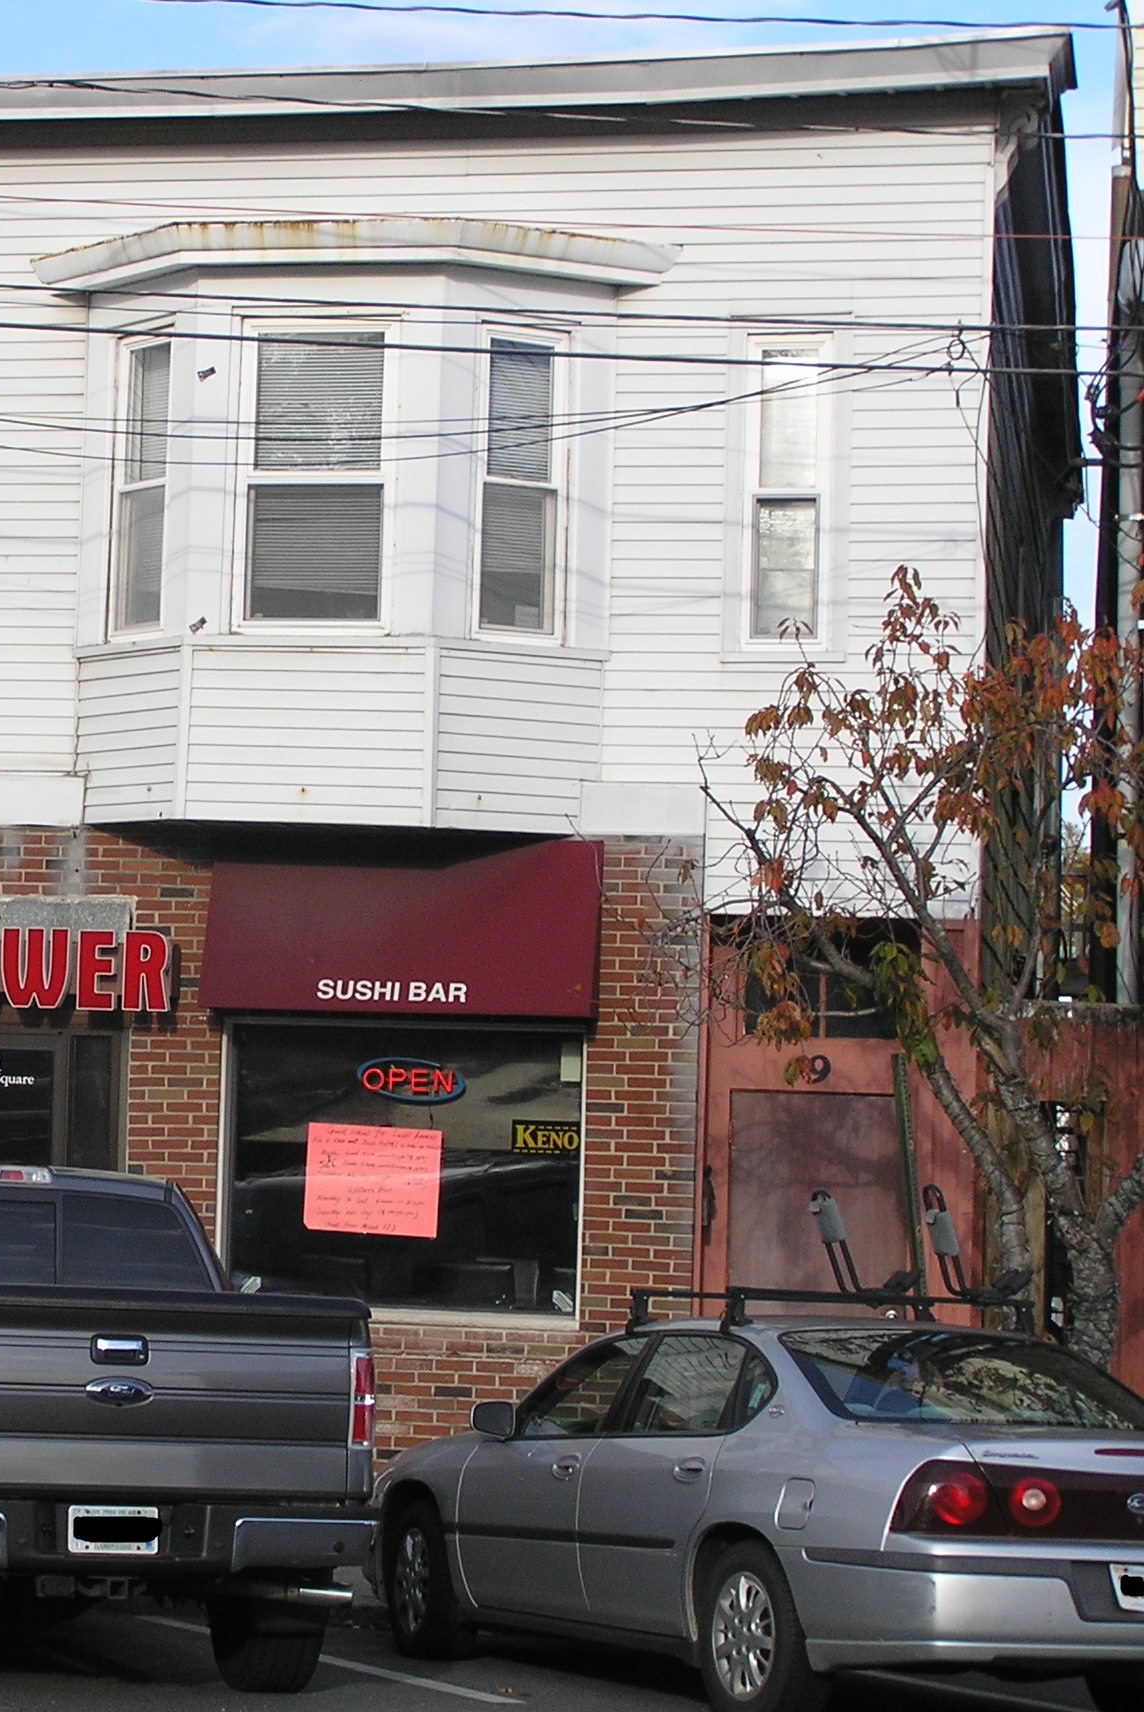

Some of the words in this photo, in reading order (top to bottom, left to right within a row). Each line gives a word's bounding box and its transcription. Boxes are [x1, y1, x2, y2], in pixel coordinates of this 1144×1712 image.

[316, 978, 401, 1002] SUSHI
[408, 982, 468, 1003] BAR
[362, 1067, 455, 1095] OPEN
[809, 1054, 832, 1084] 9
[514, 1124, 580, 1150] KENO
